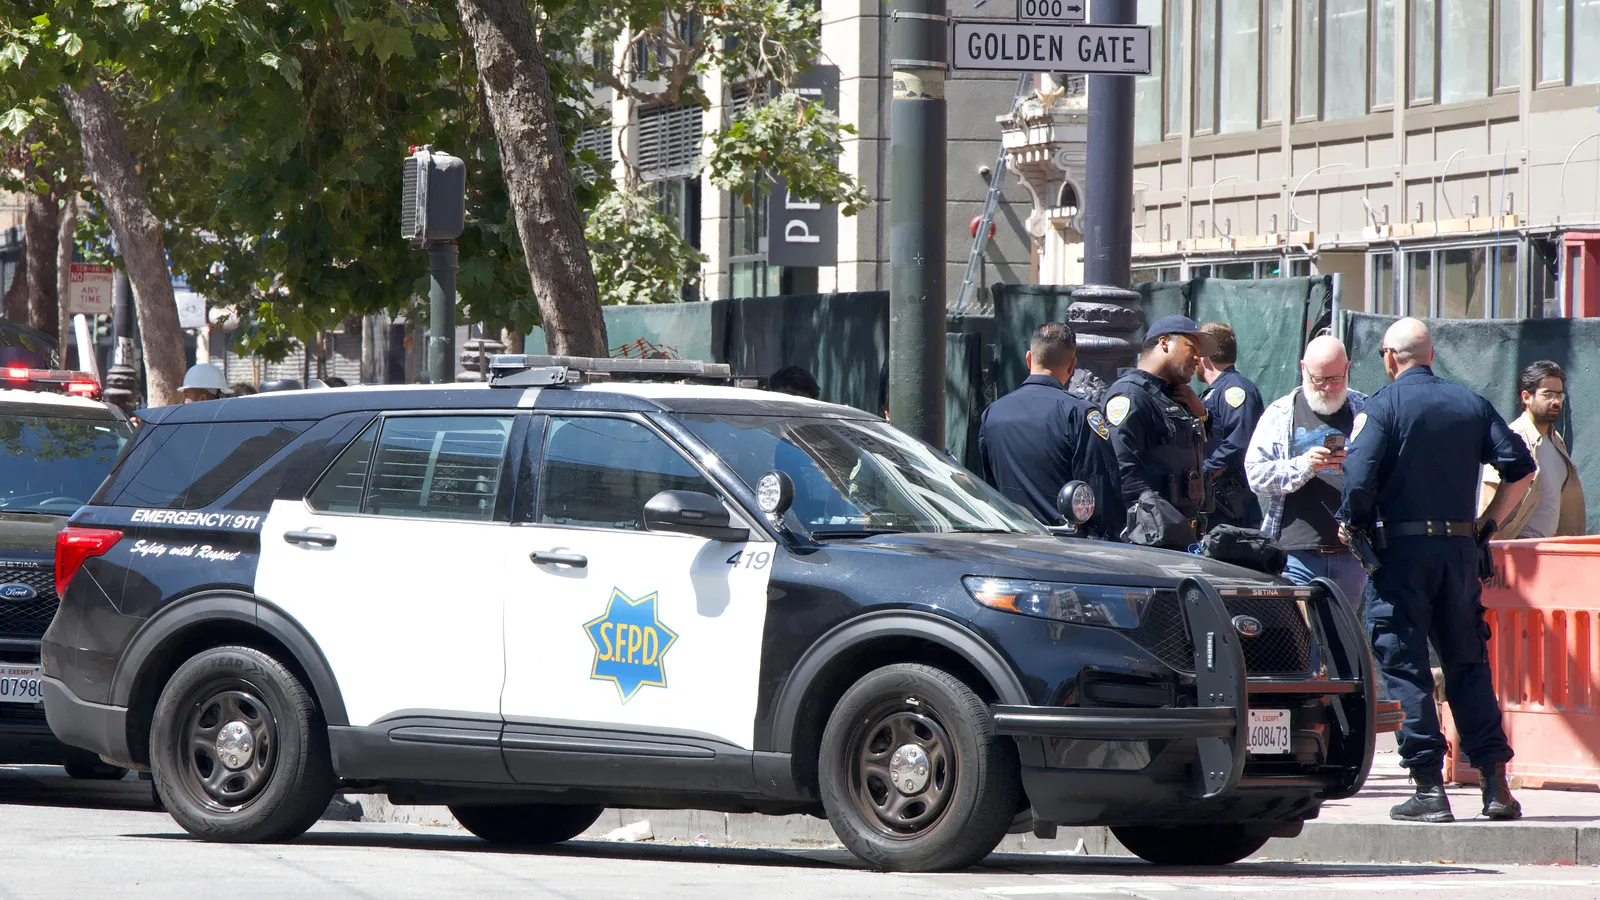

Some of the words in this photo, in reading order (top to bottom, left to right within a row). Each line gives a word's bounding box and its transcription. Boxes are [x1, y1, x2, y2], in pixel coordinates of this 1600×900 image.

[1026, 0, 1062, 17] 000
[968, 32, 1063, 61] GOLDEN
[1078, 35, 1135, 63] GATE
[71, 272, 83, 282] NO
[81, 286, 100, 294] ANY
[80, 295, 101, 304] TIME
[130, 509, 231, 527] EMERGENCY
[232, 515, 260, 529] 911
[130, 540, 167, 557] Safety
[169, 544, 197, 556] with
[194, 545, 241, 561] Respect
[726, 550, 770, 570] 419
[5, 587, 28, 597] Ford
[1243, 620, 1258, 631] Ford
[599, 621, 659, 667] S.F.P.D.
